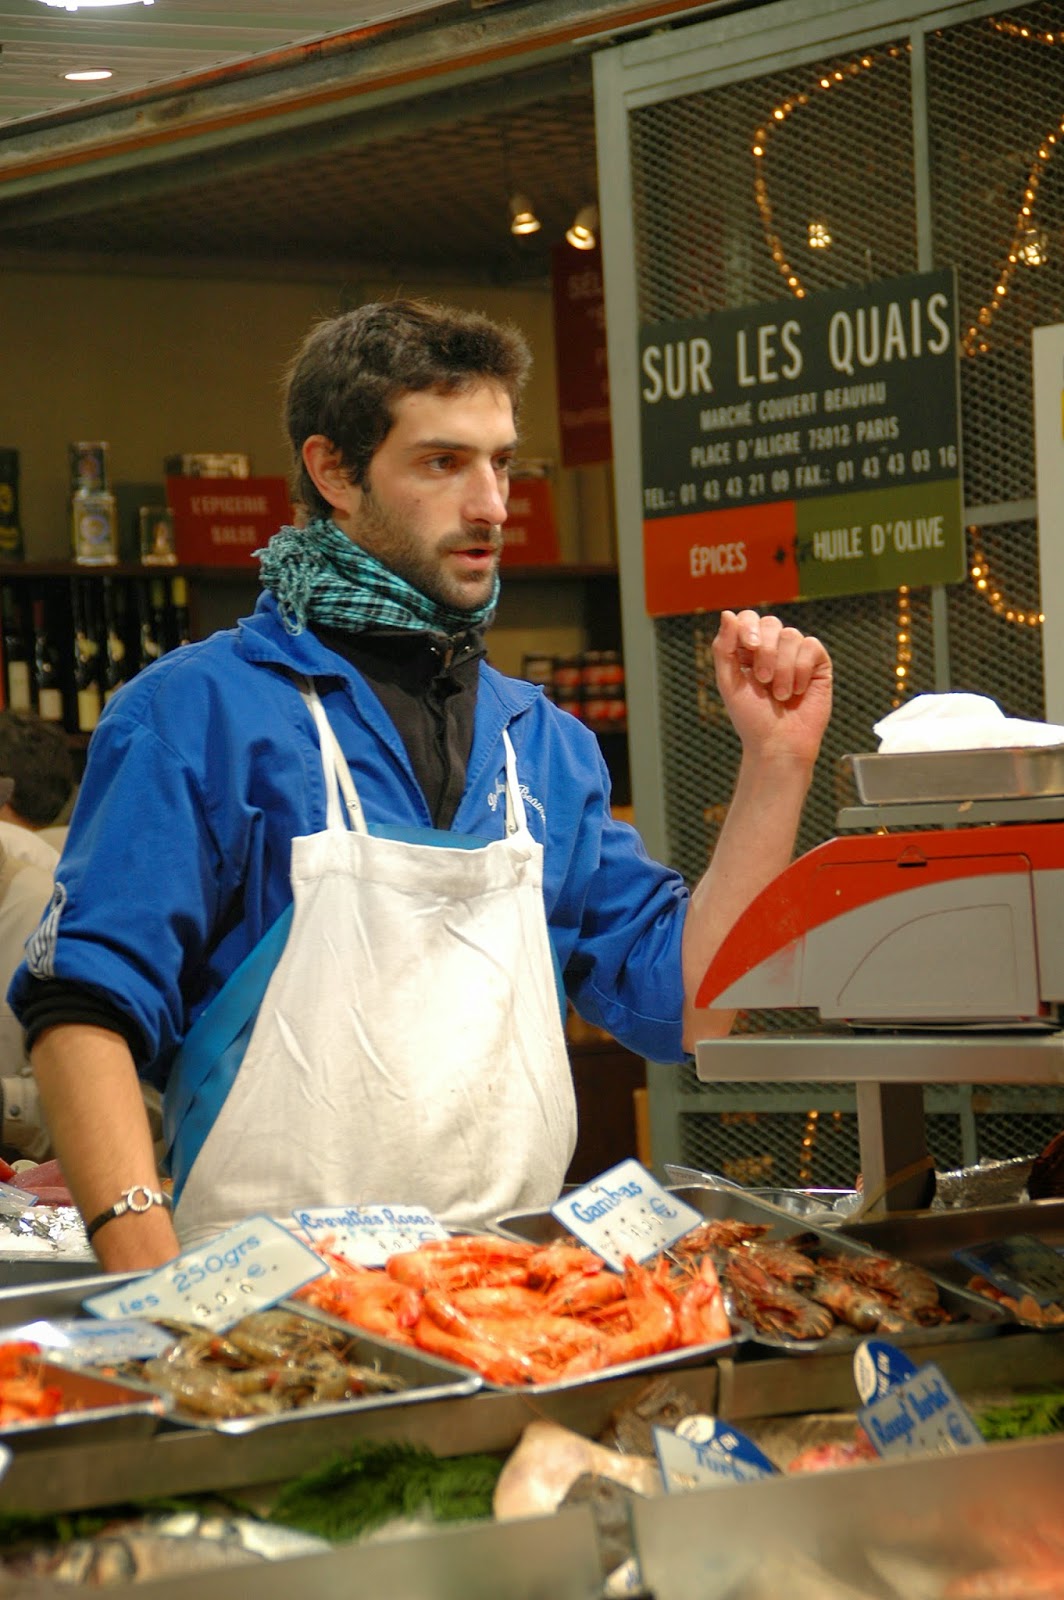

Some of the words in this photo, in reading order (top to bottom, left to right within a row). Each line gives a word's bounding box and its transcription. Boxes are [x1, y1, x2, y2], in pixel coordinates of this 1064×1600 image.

[642, 337, 713, 403] SUR
[737, 320, 803, 387] LES
[828, 293, 950, 375] QUAIS
[758, 392, 818, 424] COUVERT
[824, 381, 887, 412] BEAUVAU
[690, 441, 732, 468] PLACE
[808, 424, 850, 450] 75012
[856, 416, 899, 443] PARIS
[703, 479, 721, 502] 43
[726, 475, 743, 499] 43
[749, 473, 765, 497] 21
[836, 460, 854, 483] 01
[862, 456, 880, 479] 43
[887, 452, 905, 475] 43
[911, 449, 930, 473] 03
[938, 444, 958, 468] 16
[689, 541, 747, 577] ÉPICES
[813, 524, 864, 561] HUILE
[871, 515, 945, 555] D'OLIVE
[570, 1181, 643, 1224] Gambas
[119, 1293, 160, 1315] les
